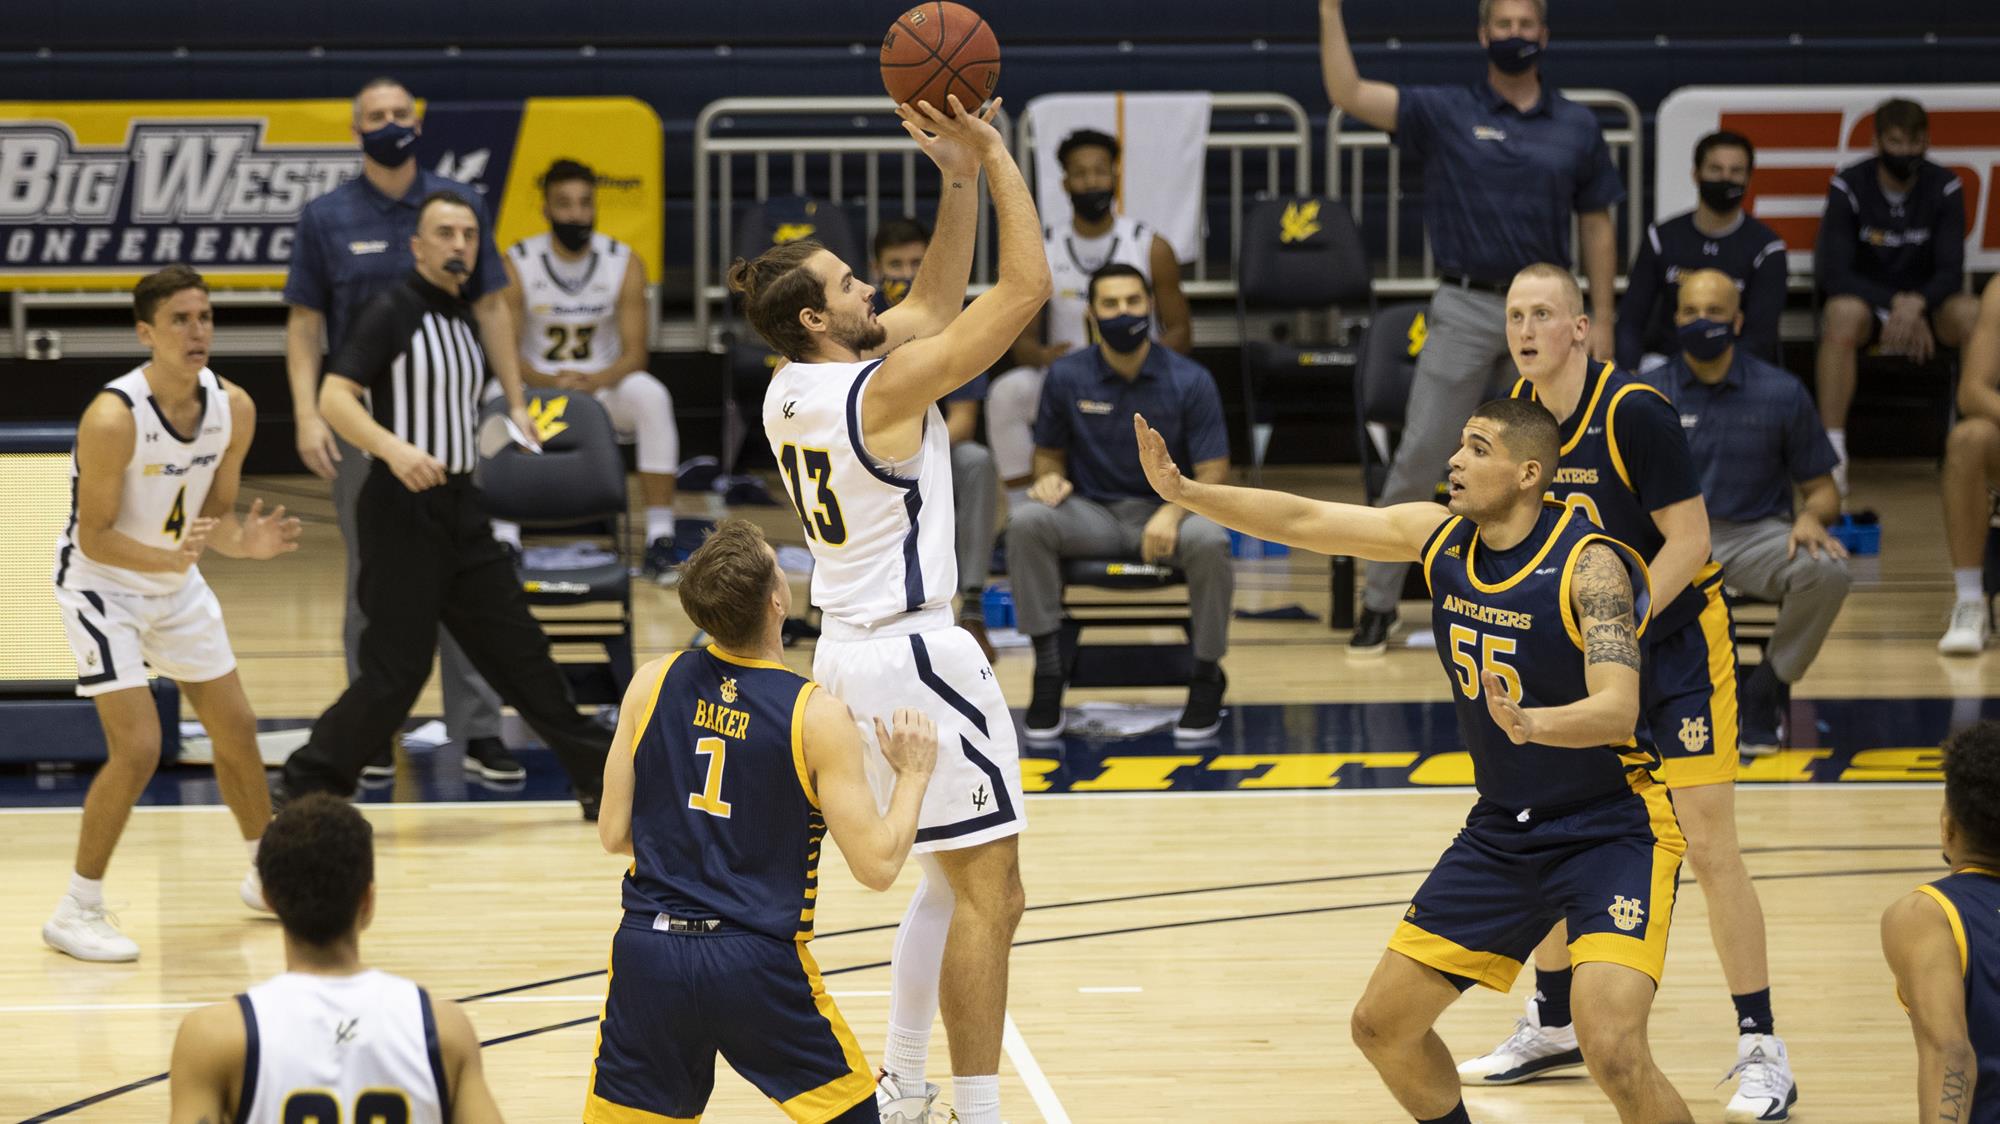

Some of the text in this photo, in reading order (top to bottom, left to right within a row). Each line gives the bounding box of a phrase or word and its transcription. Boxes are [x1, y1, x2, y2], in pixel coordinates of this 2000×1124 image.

[5, 227, 296, 263] ONFERENC
[543, 323, 598, 361] 23
[779, 441, 848, 547] 13
[1552, 467, 1599, 485] ATERS
[161, 483, 187, 543] 4
[1442, 593, 1533, 630] ANTEATERS
[1449, 622, 1524, 706] 55
[693, 698, 750, 740] BAKER
[687, 736, 732, 819] 1
